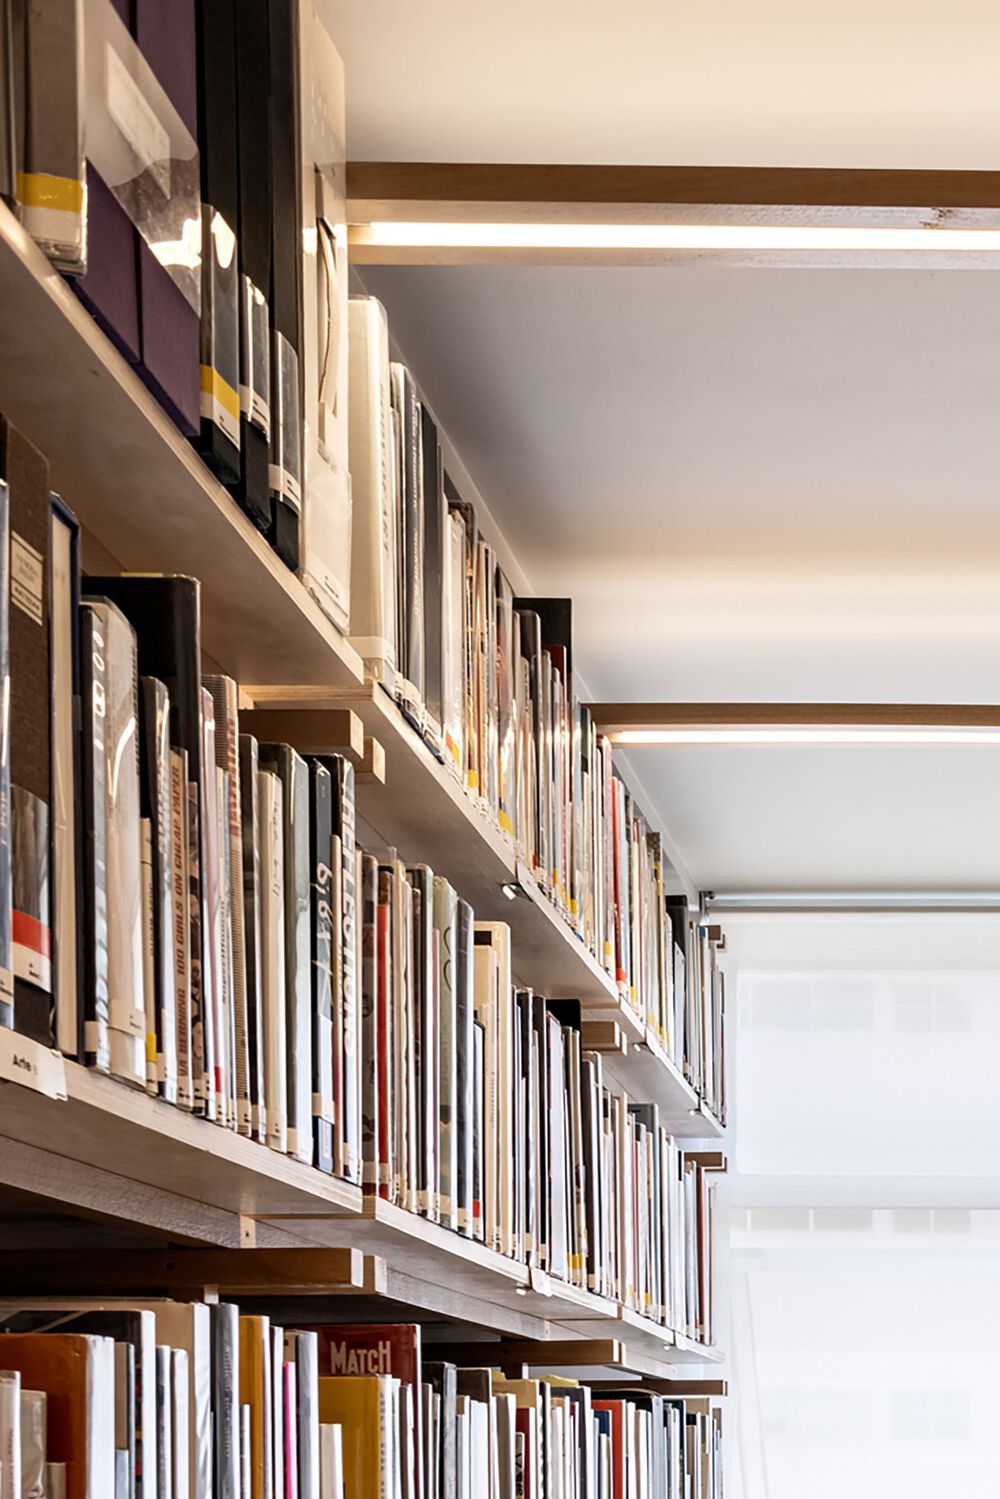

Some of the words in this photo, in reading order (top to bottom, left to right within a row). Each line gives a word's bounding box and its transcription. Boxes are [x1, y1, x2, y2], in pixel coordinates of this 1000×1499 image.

[171, 766, 181, 816] PAPER
[172, 819, 182, 870] CHEAP
[173, 874, 182, 897] ON
[174, 903, 184, 945] GIRLS
[342, 798, 355, 1057] REFLECTIONS
[175, 950, 185, 977] 100
[177, 988, 187, 1054] BERNING
[12, 1054, 32, 1072] Arte
[329, 1340, 393, 1375] MATCH
